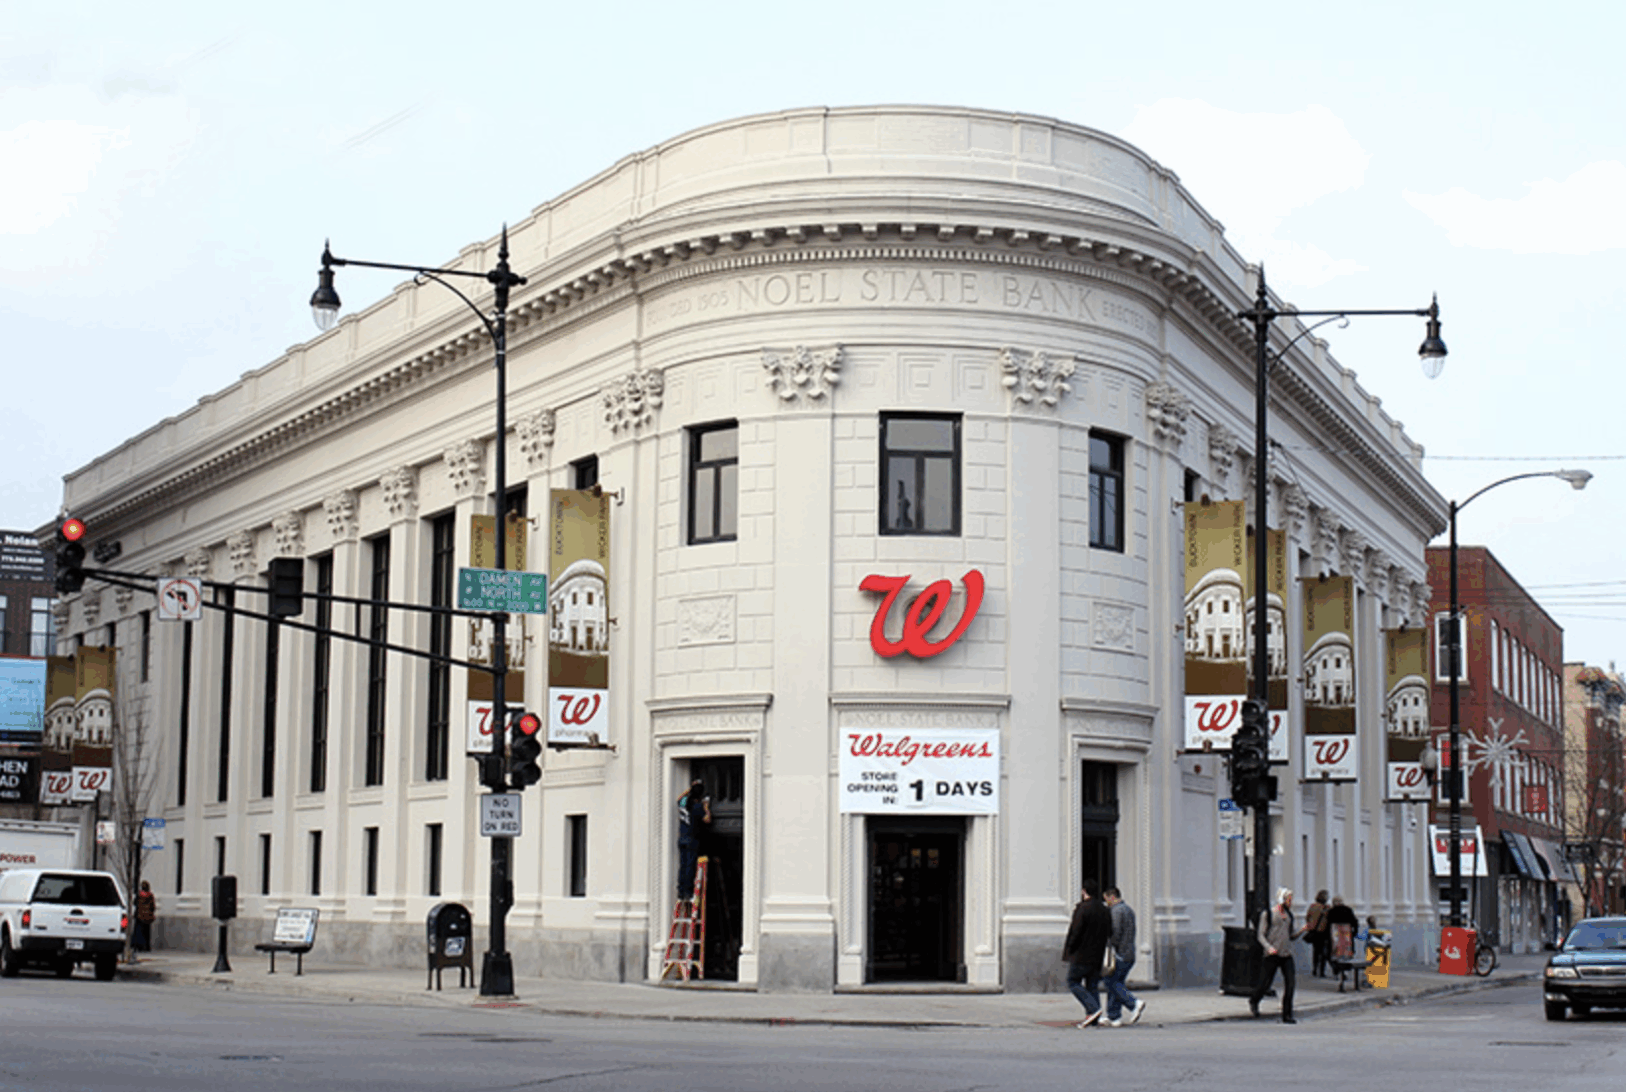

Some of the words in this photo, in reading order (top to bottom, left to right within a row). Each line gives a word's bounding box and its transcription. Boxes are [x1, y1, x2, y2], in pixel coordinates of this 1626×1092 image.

[736, 271, 841, 311] NOEL
[860, 268, 980, 304] STATE
[1002, 275, 1097, 322] BANK
[479, 572, 522, 586] DAMEN
[481, 586, 521, 600] NORTH
[859, 569, 985, 658] W
[848, 733, 993, 766] Walgreens
[861, 772, 897, 781] STORE
[847, 783, 898, 793] OPENING
[909, 779, 924, 801] 1
[936, 781, 993, 796] DAYS
[492, 798, 509, 808] NO
[489, 810, 514, 819] TURN
[484, 822, 497, 831] ON
[501, 822, 518, 831] RED
